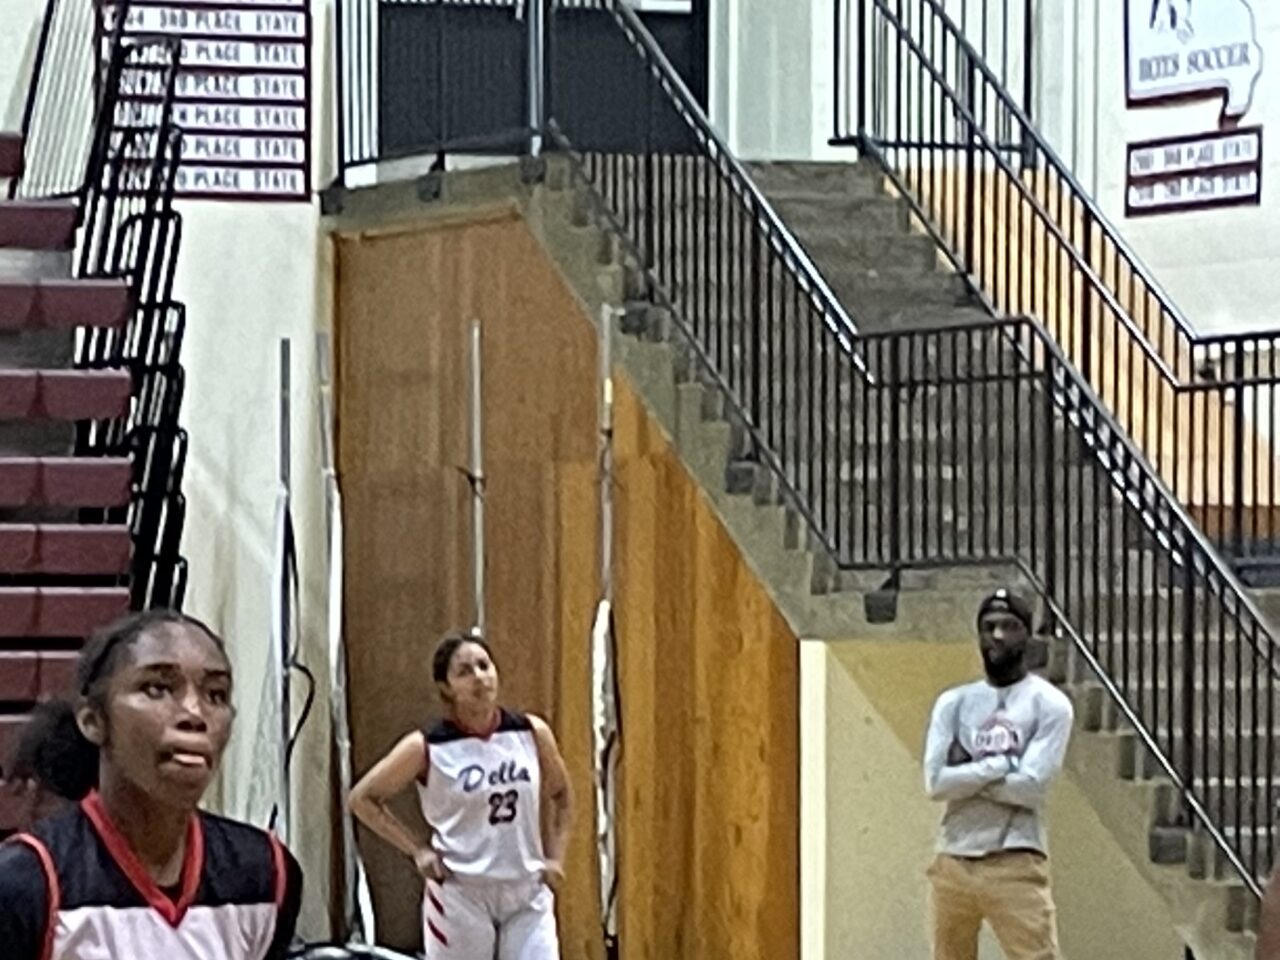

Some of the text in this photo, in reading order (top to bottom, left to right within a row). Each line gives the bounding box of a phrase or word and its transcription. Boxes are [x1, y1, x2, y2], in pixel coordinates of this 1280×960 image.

[1187, 42, 1250, 75] SOCCER
[456, 759, 531, 792] Della
[488, 788, 519, 826] 23
